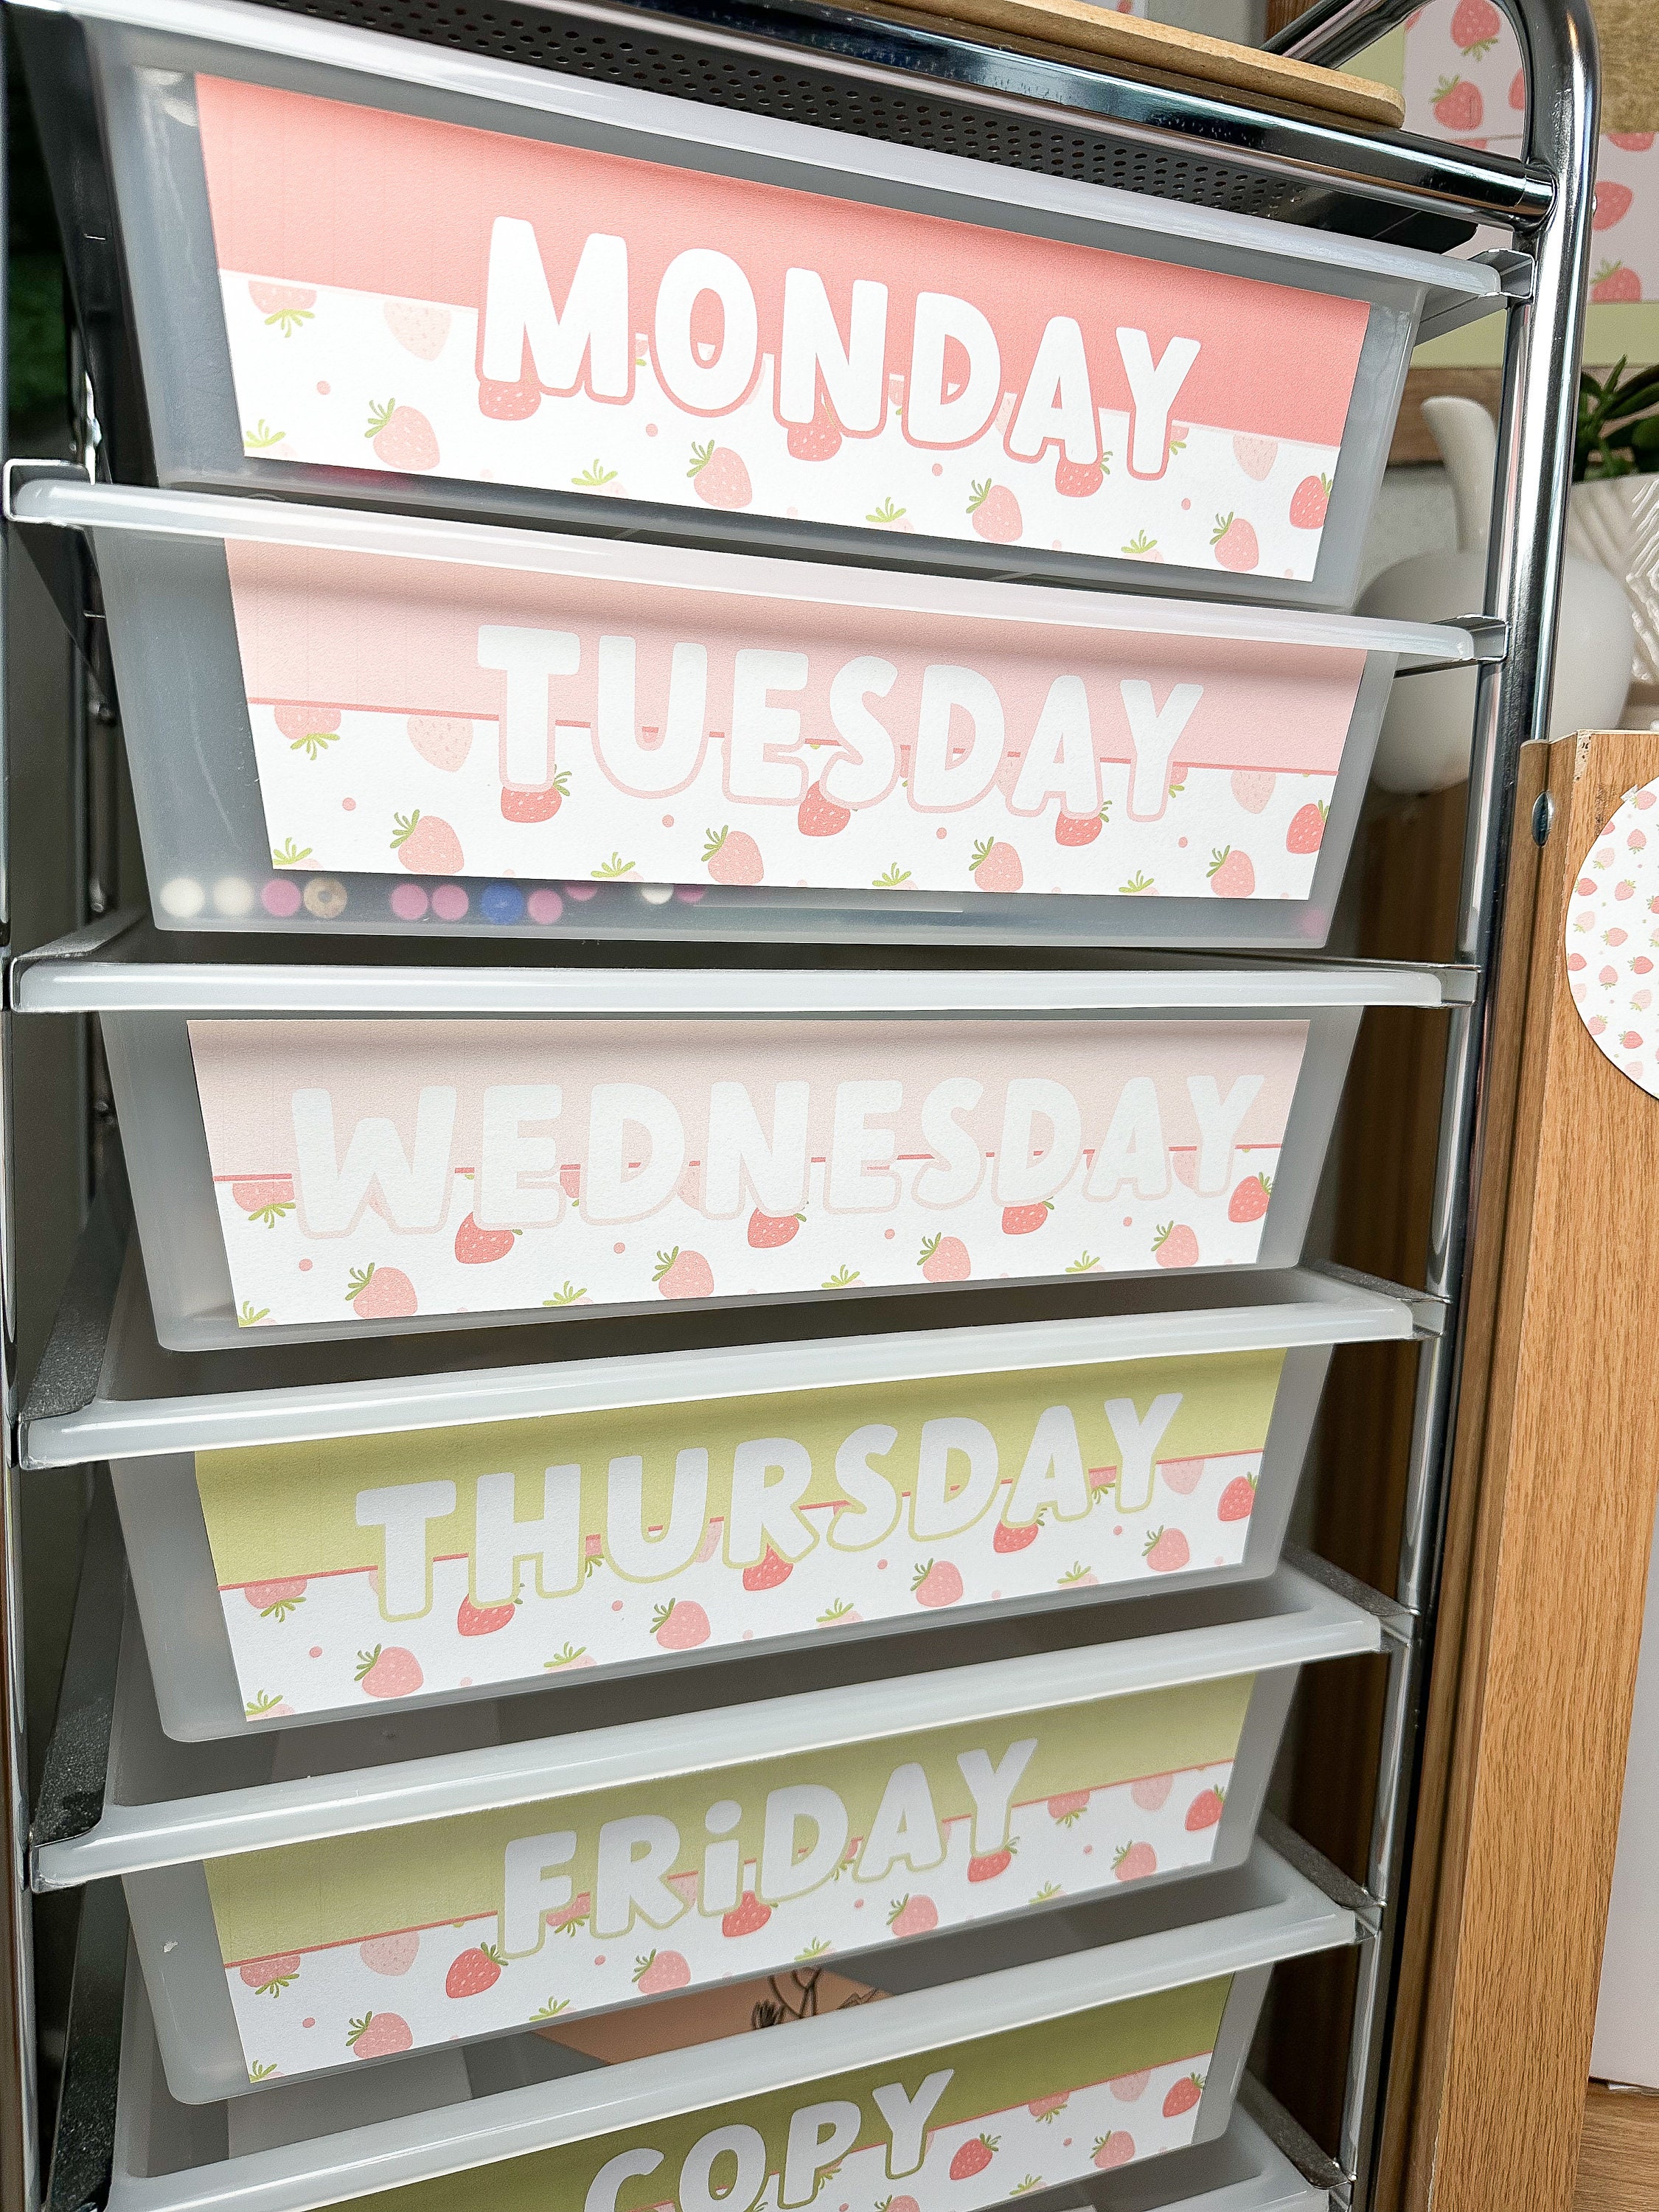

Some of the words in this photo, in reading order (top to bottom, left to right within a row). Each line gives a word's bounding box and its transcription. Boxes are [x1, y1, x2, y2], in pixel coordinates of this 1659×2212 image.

[478, 215, 1202, 476] MONDAY
[476, 623, 1203, 818] TUESDAY
[288, 1074, 1264, 1237] WEDNESDAY
[354, 1391, 1184, 1621] THURSDAY
[582, 2067, 955, 2212] COPY
